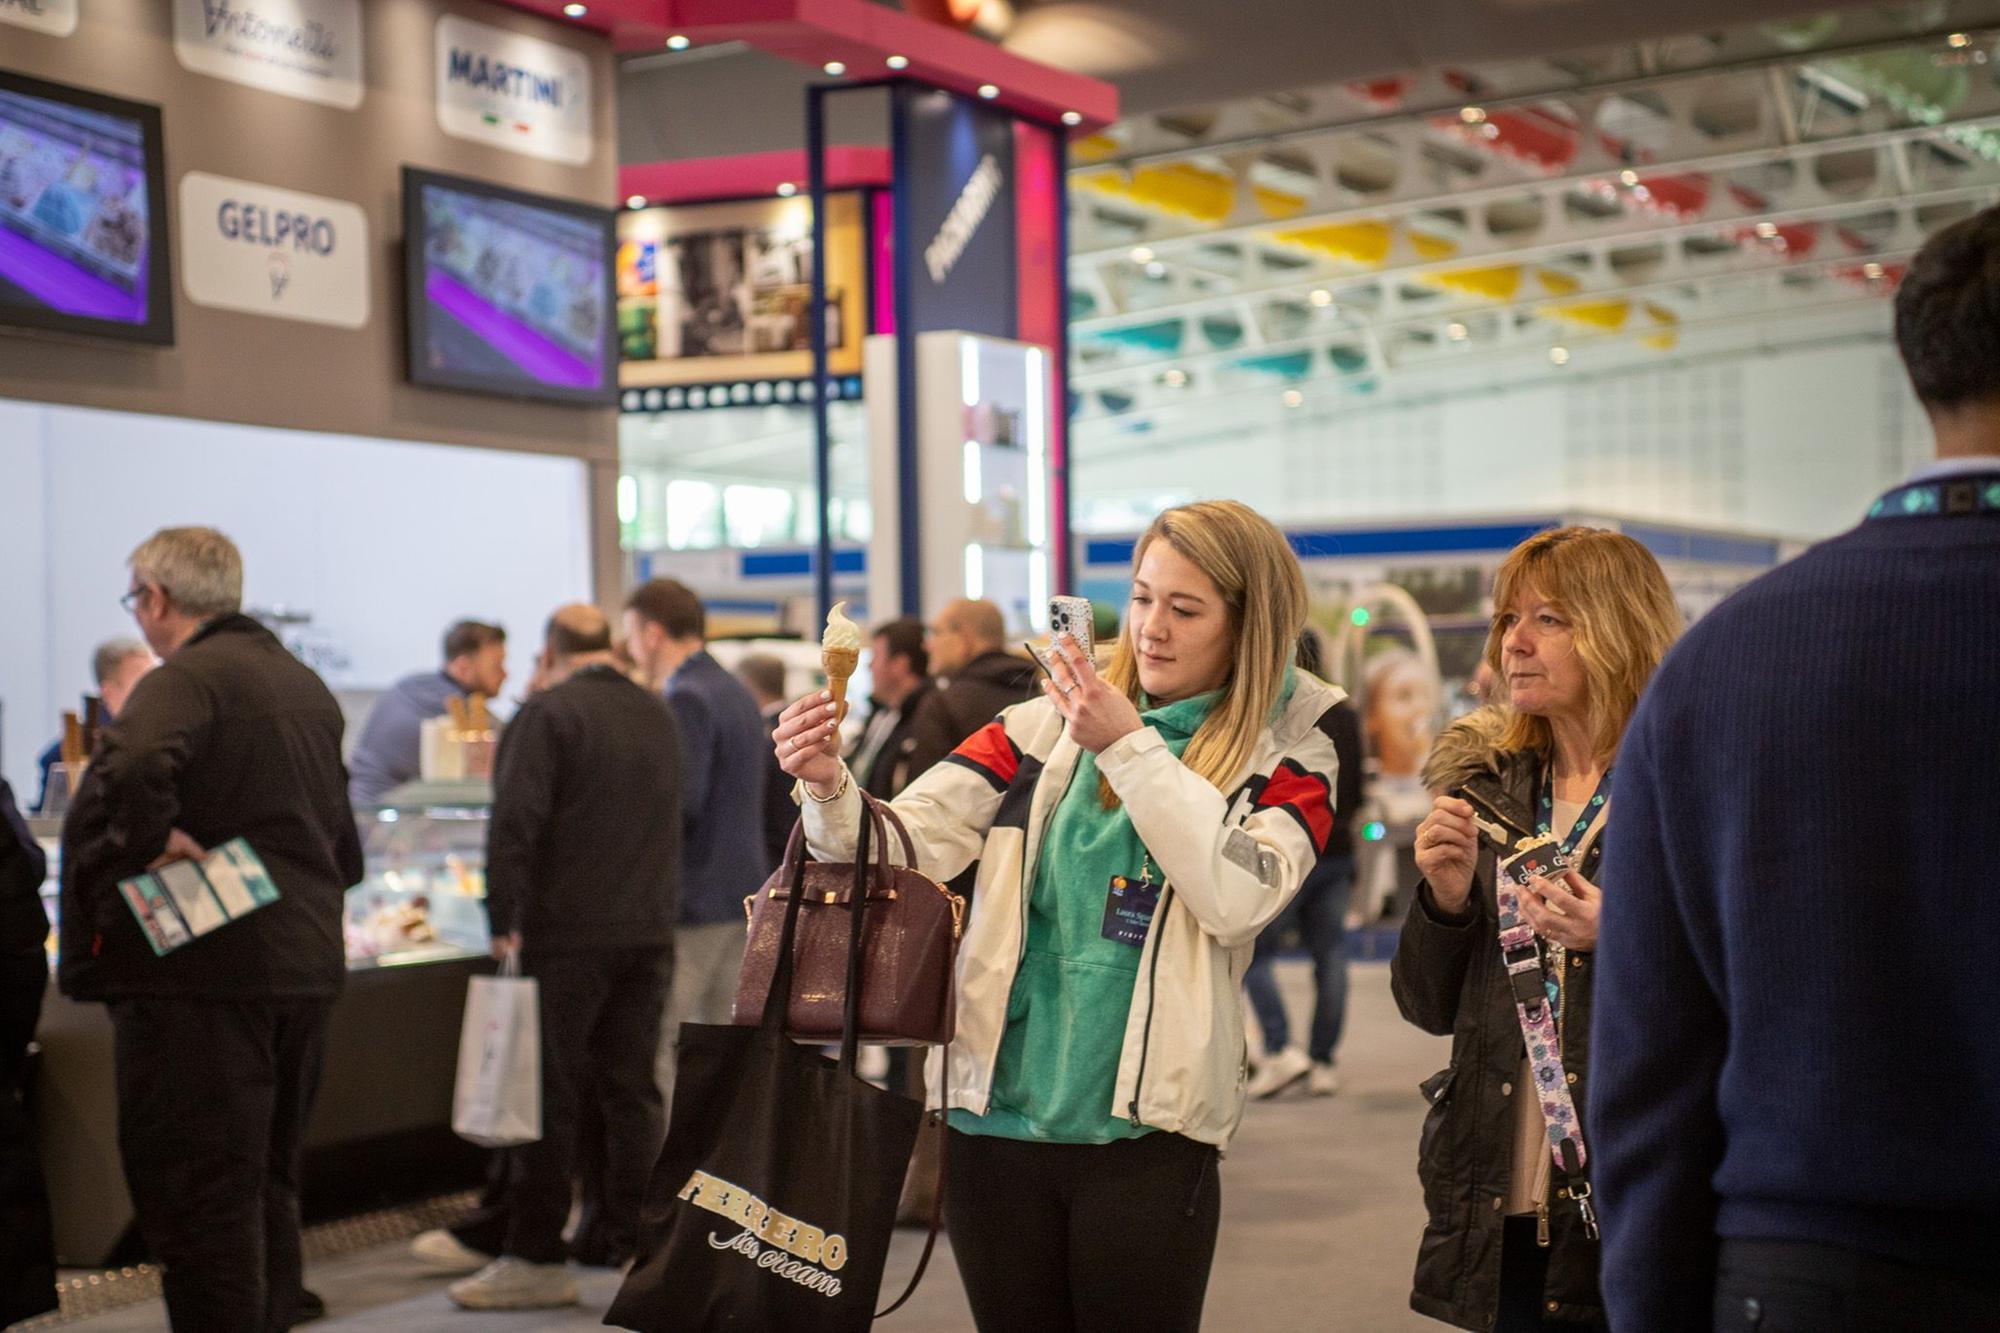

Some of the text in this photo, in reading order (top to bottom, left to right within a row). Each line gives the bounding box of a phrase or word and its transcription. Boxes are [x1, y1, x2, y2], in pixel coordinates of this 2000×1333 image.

[218, 198, 336, 256] GELPRO
[677, 1170, 848, 1270] FERRERO
[757, 1250, 842, 1297] cream
